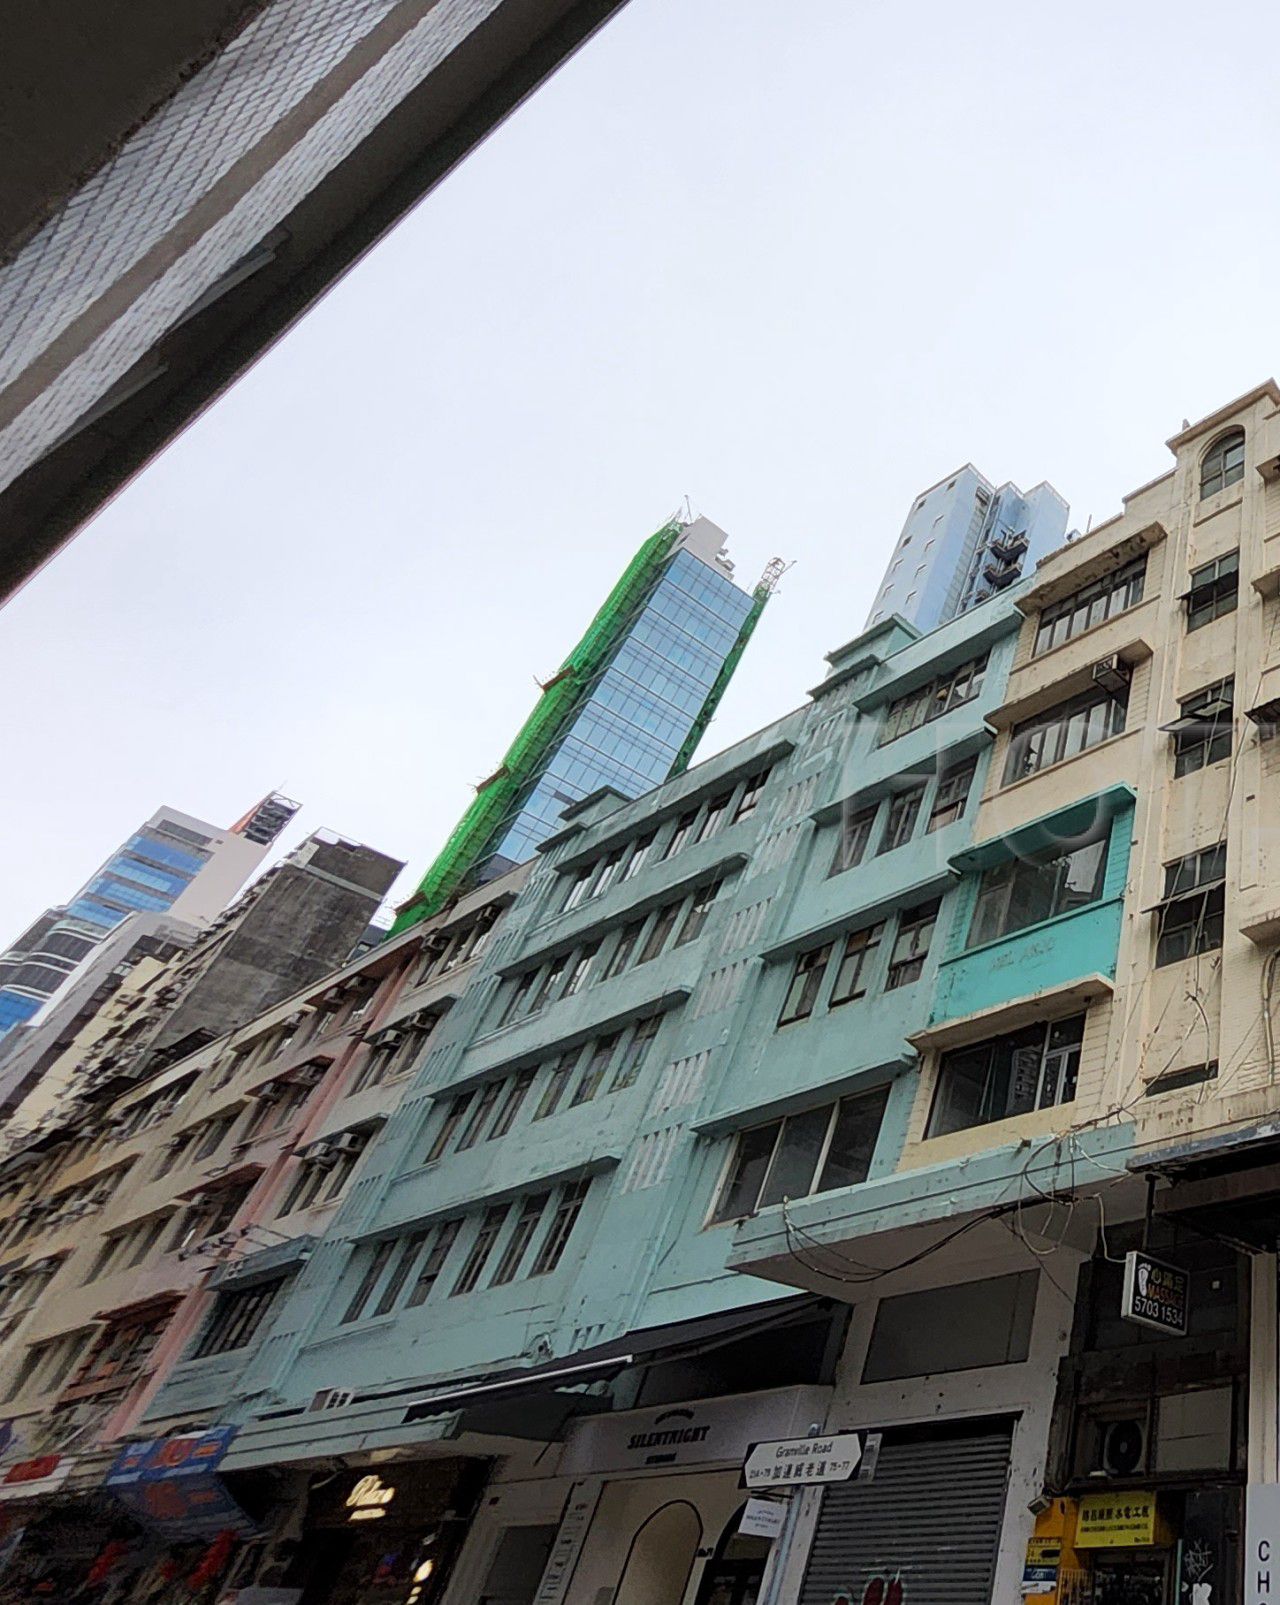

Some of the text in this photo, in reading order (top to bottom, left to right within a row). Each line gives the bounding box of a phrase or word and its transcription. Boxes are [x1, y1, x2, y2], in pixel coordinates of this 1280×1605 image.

[1134, 1295, 1184, 1326] 5703 1534
[627, 1425, 711, 1449] SILENTNIGHT
[775, 1441, 834, 1458] Granville Road
[771, 1460, 827, 1480] 加連威老道
[1257, 1540, 1270, 1605] CH
